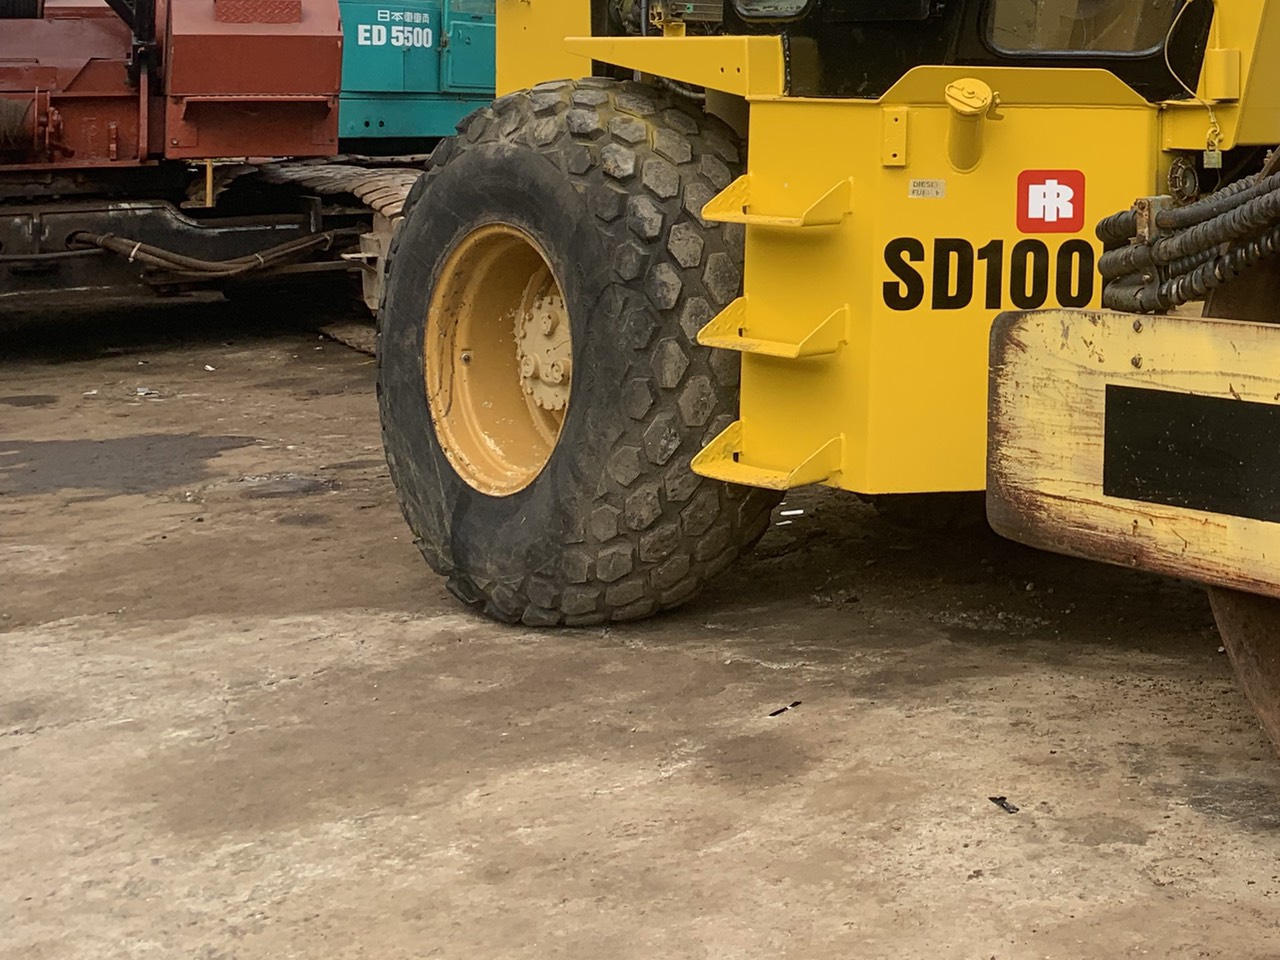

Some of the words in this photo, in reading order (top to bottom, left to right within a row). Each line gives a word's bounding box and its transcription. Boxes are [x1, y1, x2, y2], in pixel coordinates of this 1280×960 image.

[357, 24, 387, 46] ED
[390, 26, 433, 49] 5500
[882, 236, 1106, 312] SD100
